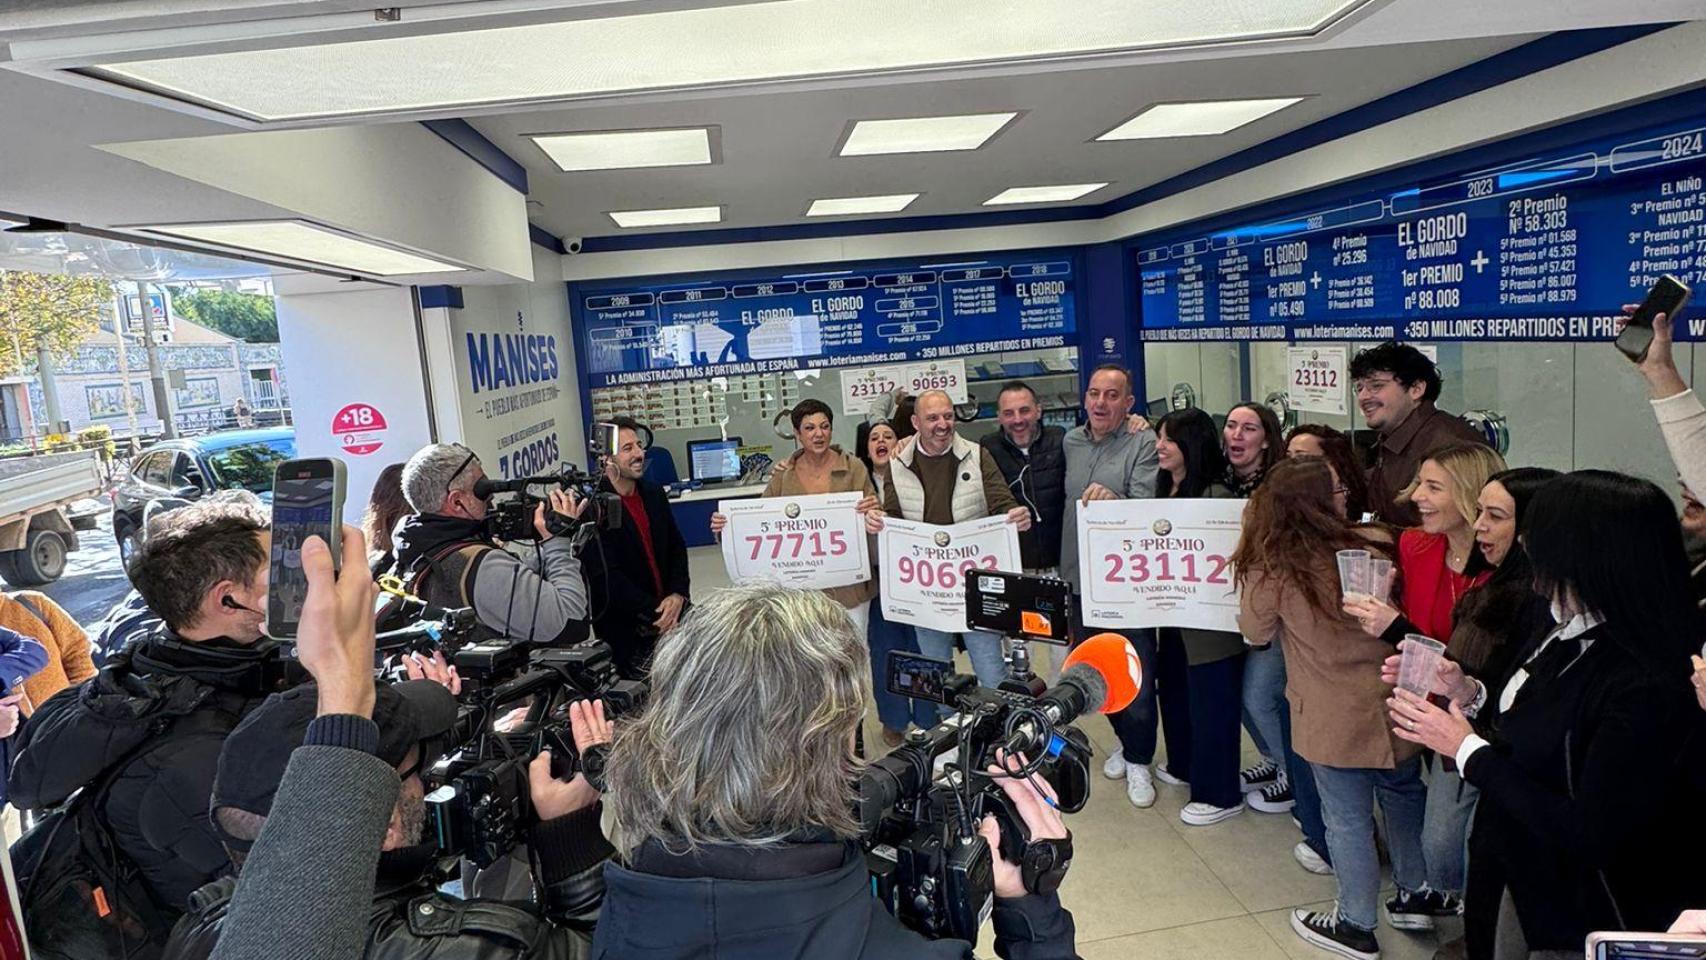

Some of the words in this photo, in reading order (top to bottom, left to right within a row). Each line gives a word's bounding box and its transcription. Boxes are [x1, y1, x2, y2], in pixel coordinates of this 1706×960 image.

[1662, 133, 1703, 159] 2024
[1468, 178, 1493, 198] 2023
[1662, 183, 1673, 195] EL
[1676, 177, 1702, 193] NIÑO
[1524, 193, 1567, 215] Premio
[1645, 197, 1682, 213] Premio
[1307, 216, 1323, 230] 2022
[1525, 212, 1567, 233] 58.303
[1658, 209, 1703, 226] NAVIDAD
[1398, 222, 1414, 246] EL
[1417, 212, 1467, 243] GORDO
[1643, 228, 1680, 243] Premio
[1341, 233, 1367, 249] Premio
[1510, 236, 1537, 249] Premio
[1264, 248, 1275, 266] EL
[1276, 241, 1307, 264] GORDO
[1342, 250, 1367, 265] 25.296
[1406, 244, 1417, 260] de
[1419, 240, 1457, 258] NAVIDAD
[1510, 250, 1536, 262] Premio
[1643, 243, 1679, 257] Premio
[1269, 267, 1277, 277] de
[1278, 263, 1302, 276] NAVIDAD
[1511, 264, 1537, 276] Premio
[1549, 260, 1575, 273] 57.421
[1642, 257, 1678, 272] Premio
[1402, 270, 1418, 287] 1er
[1420, 263, 1463, 285] PREMIO
[828, 280, 844, 290] 2013
[1016, 284, 1029, 297] EL
[1031, 281, 1065, 296] GORDO
[1279, 281, 1306, 298] PREMIO
[1509, 278, 1536, 290] Premio
[812, 299, 825, 313] EL
[827, 296, 863, 312] GORDO
[1033, 295, 1059, 305] NAVIDAD
[1419, 289, 1460, 309] 88.008
[1509, 292, 1536, 304] Premio
[820, 313, 829, 321] de
[830, 310, 858, 321] NAVIDAD
[1279, 301, 1305, 316] 05.490
[742, 311, 755, 325] EL
[1259, 325, 1286, 339] NAVIDAD
[1294, 323, 1394, 339] www.loteriamanises.com
[1431, 320, 1485, 338] MILLONES
[1488, 317, 1566, 337] REPARTIDOS
[1569, 317, 1589, 337] EN
[807, 351, 906, 368] www.loteriamanises.com
[939, 343, 975, 357] MILLONES
[976, 339, 1019, 353] REPARTIDOS
[1021, 338, 1031, 348] EN
[1032, 336, 1065, 348] PREMIOS
[466, 333, 558, 394] MANISES
[606, 374, 617, 385] LA
[618, 367, 684, 383] ADMINISTRACIÓN
[687, 365, 703, 379] MÁS
[705, 363, 755, 378] AFORTUNADA
[757, 362, 767, 373] DE
[769, 358, 798, 371] ESPAÑA
[912, 375, 957, 391] 90693
[1295, 369, 1337, 388] 23112
[851, 381, 895, 397] 23112
[341, 407, 374, 426] +18
[499, 455, 509, 481] 7
[512, 432, 560, 480] GORDOS
[774, 518, 828, 532] PREMIO
[745, 530, 847, 560] 77715
[925, 544, 980, 560] PREMIO
[1140, 538, 1205, 551] PREMIO
[1104, 553, 1228, 584] 23112
